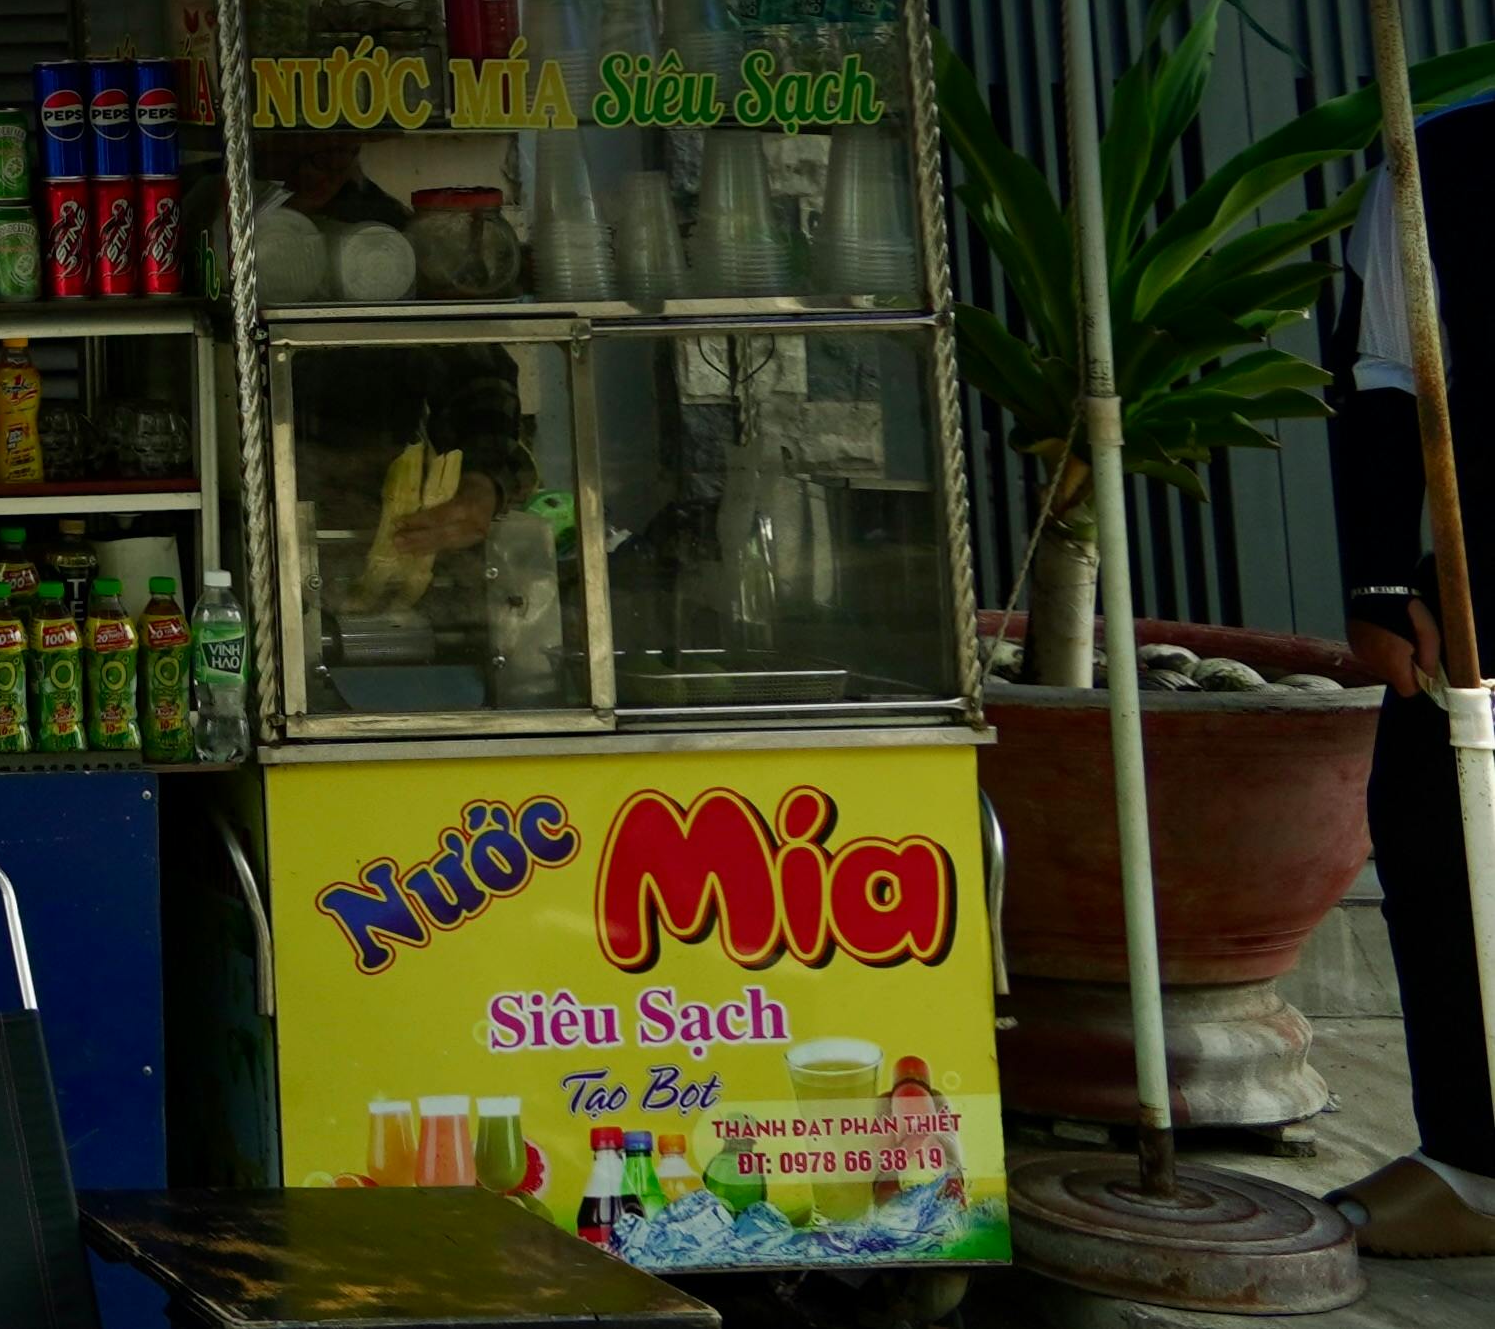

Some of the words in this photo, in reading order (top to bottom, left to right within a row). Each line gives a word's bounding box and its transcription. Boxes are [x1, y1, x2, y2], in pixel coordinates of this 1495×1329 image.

[252, 35, 433, 129] NƯỚC
[449, 35, 578, 130] MÍA
[593, 49, 723, 129] Siêu
[733, 47, 883, 135] Sạch
[316, 795, 581, 975] Nước
[596, 785, 956, 973] Mía
[487, 989, 620, 1051] Siêu
[638, 985, 788, 1058] Sạch
[560, 1068, 628, 1122] Tạo
[640, 1063, 723, 1116] Bọt
[712, 1114, 786, 1138] THÀNH
[792, 1118, 833, 1142] ĐẠT
[841, 1116, 899, 1136] PHAN
[904, 1105, 962, 1133] THIẾT
[738, 1153, 772, 1174] ĐT:
[780, 1151, 837, 1174] 0978
[844, 1149, 872, 1172] 66
[879, 1147, 907, 1171] 38
[916, 1147, 943, 1170] 19
